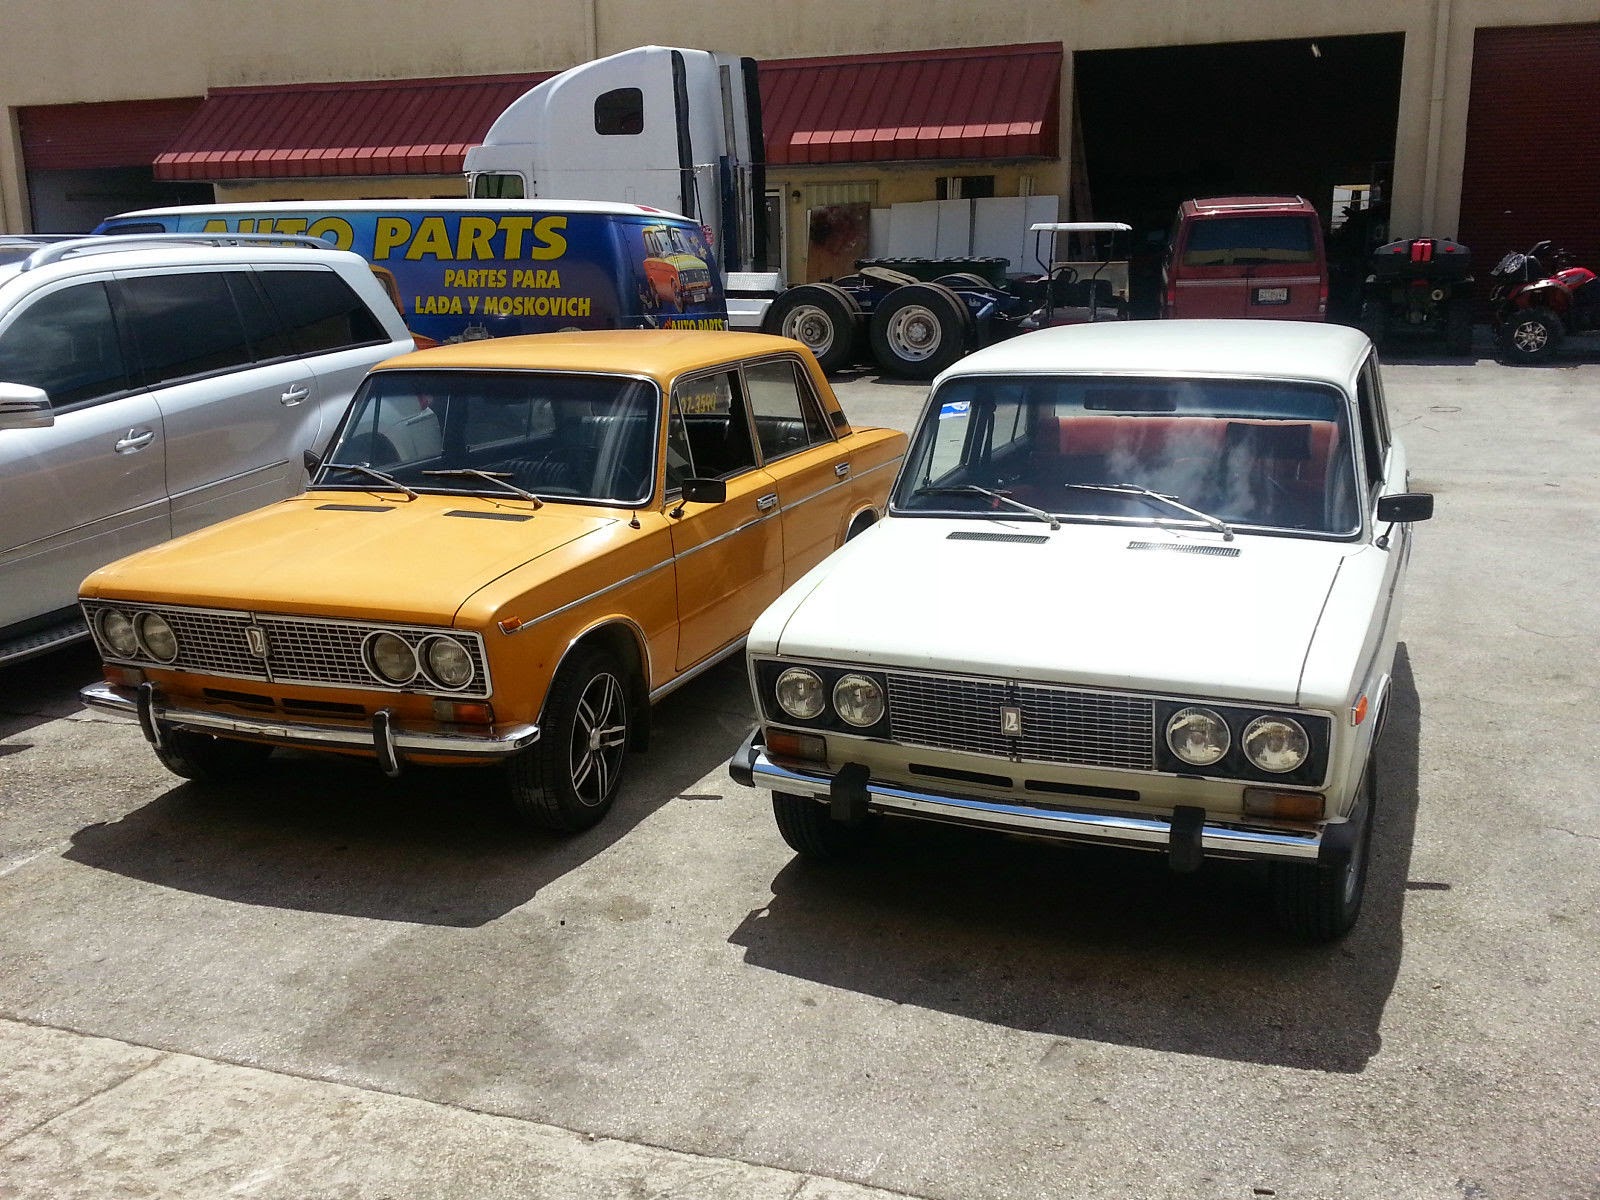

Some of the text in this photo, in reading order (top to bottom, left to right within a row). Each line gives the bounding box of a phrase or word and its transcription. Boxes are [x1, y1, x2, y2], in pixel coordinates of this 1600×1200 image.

[373, 216, 567, 261] PARTS
[445, 269, 561, 289] PARTES PARA
[415, 296, 591, 317] LADA Y MOSKOVICH
[671, 318, 723, 331] AUTO PARTS
